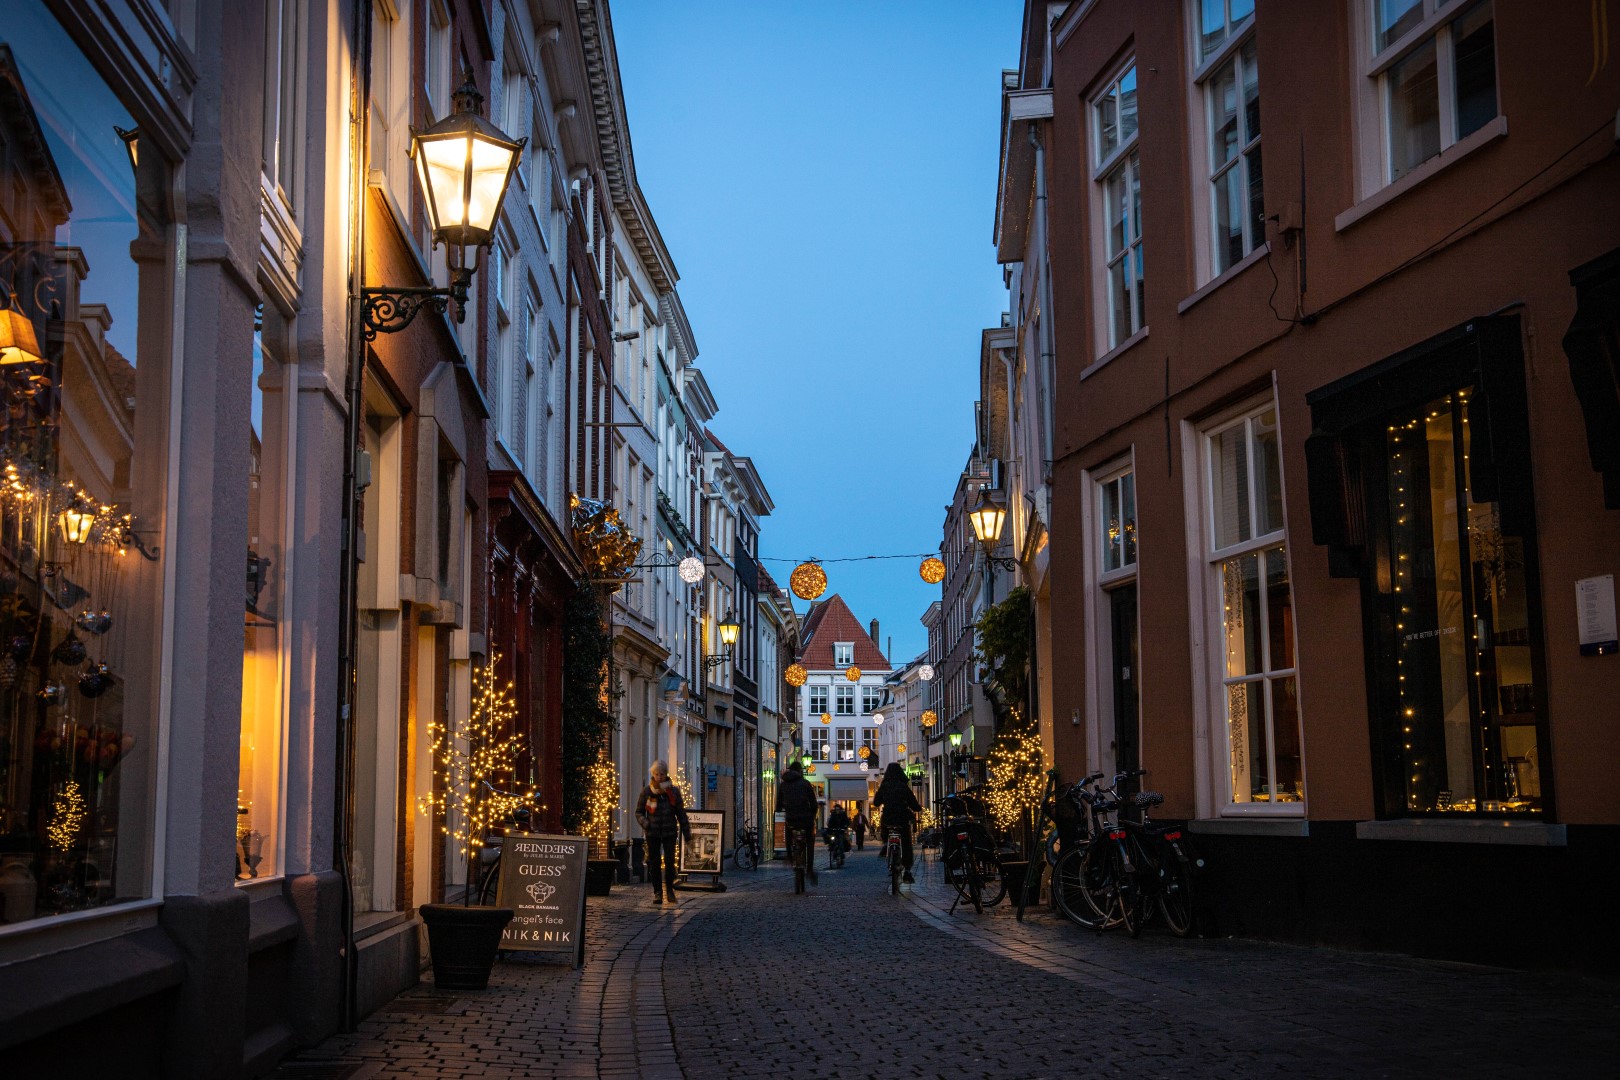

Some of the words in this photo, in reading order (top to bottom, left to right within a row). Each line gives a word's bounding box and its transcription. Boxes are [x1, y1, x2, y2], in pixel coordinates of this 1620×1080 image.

[545, 915, 564, 924] face
[502, 929, 529, 941] NIK
[532, 930, 539, 941] &
[544, 931, 570, 942] NIK
